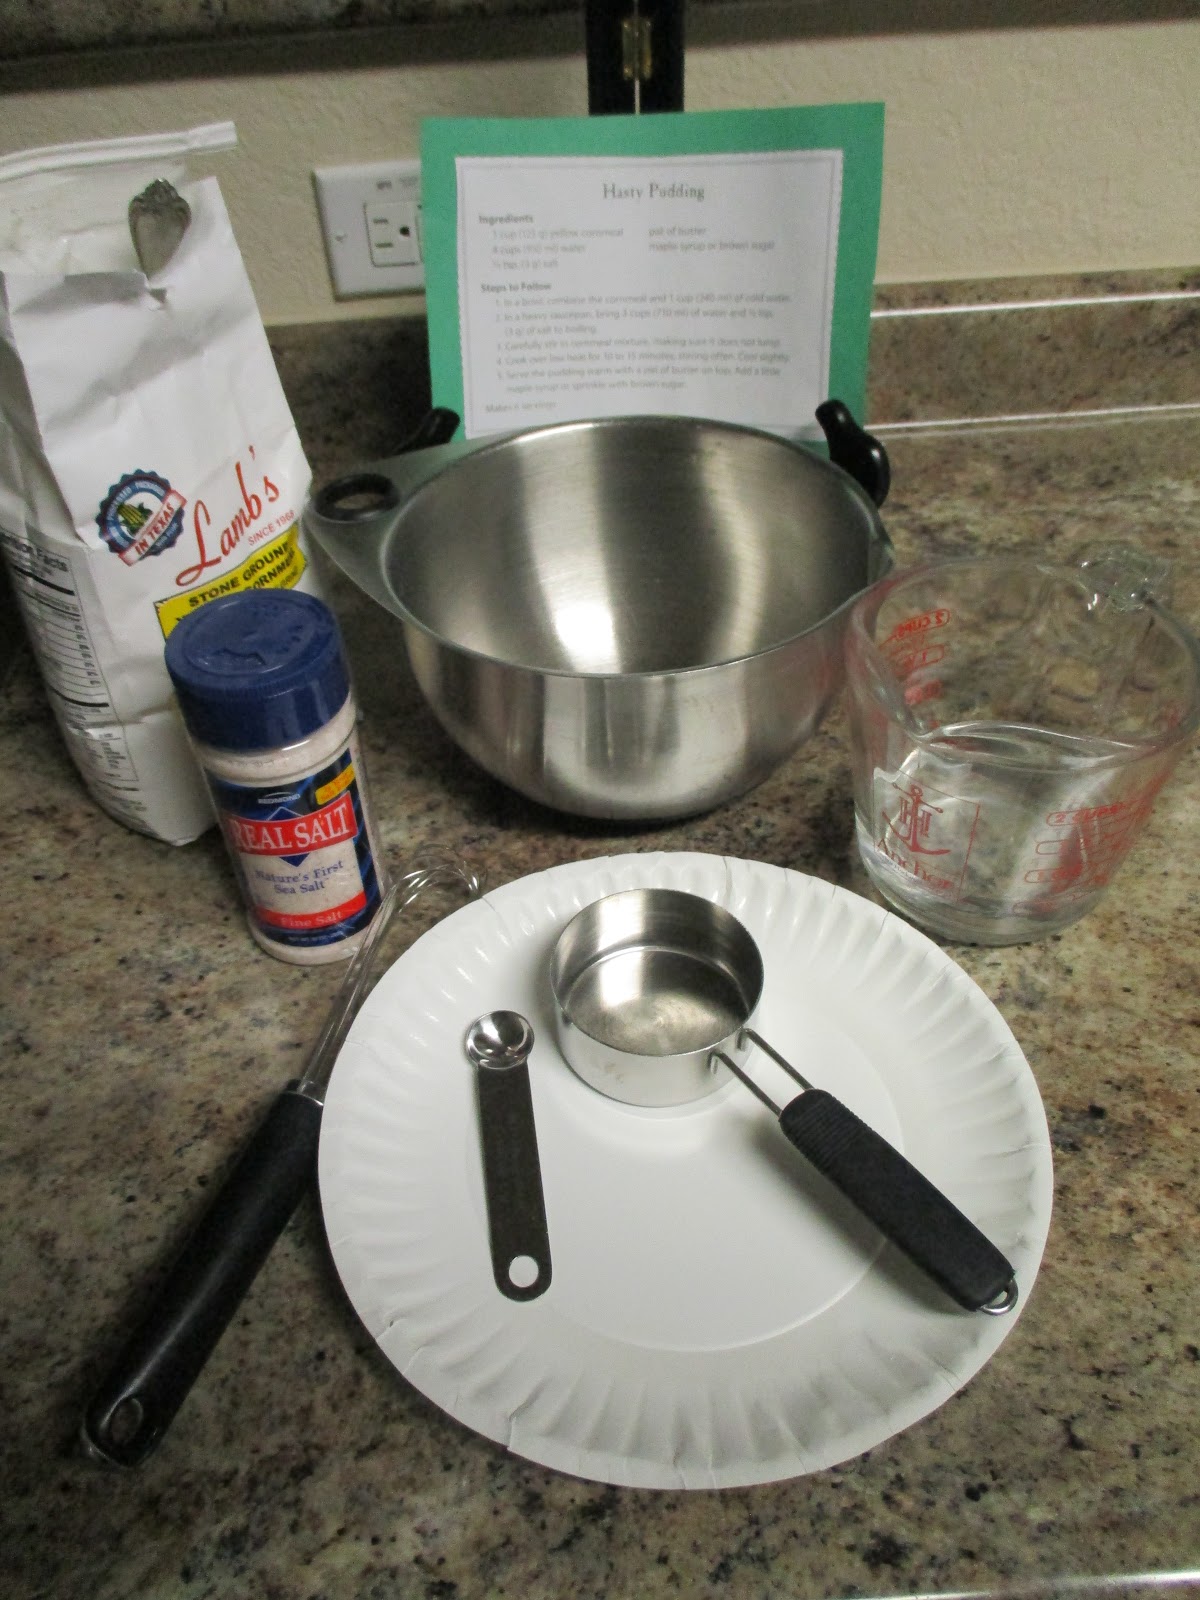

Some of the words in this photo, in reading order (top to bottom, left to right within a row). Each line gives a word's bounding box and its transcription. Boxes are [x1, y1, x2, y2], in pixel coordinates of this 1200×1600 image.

[603, 182, 642, 202] Hasty
[650, 182, 705, 201] Pudding
[478, 213, 534, 226] Ingredients
[481, 283, 507, 293] Steps
[509, 283, 519, 292] to
[521, 281, 552, 291] Follow
[176, 445, 280, 586] Lamb's
[134, 538, 149, 555] IN
[148, 502, 175, 540] TEXAS
[249, 526, 276, 546] SINCE
[188, 576, 240, 608] STONE
[233, 817, 292, 850] REAL
[294, 803, 351, 848] SALT
[256, 868, 310, 884] Nature's
[314, 861, 344, 879] First
[274, 883, 296, 895] Sea
[300, 880, 325, 894] Salt
[281, 917, 312, 928] Fine
[317, 910, 343, 924] Salt
